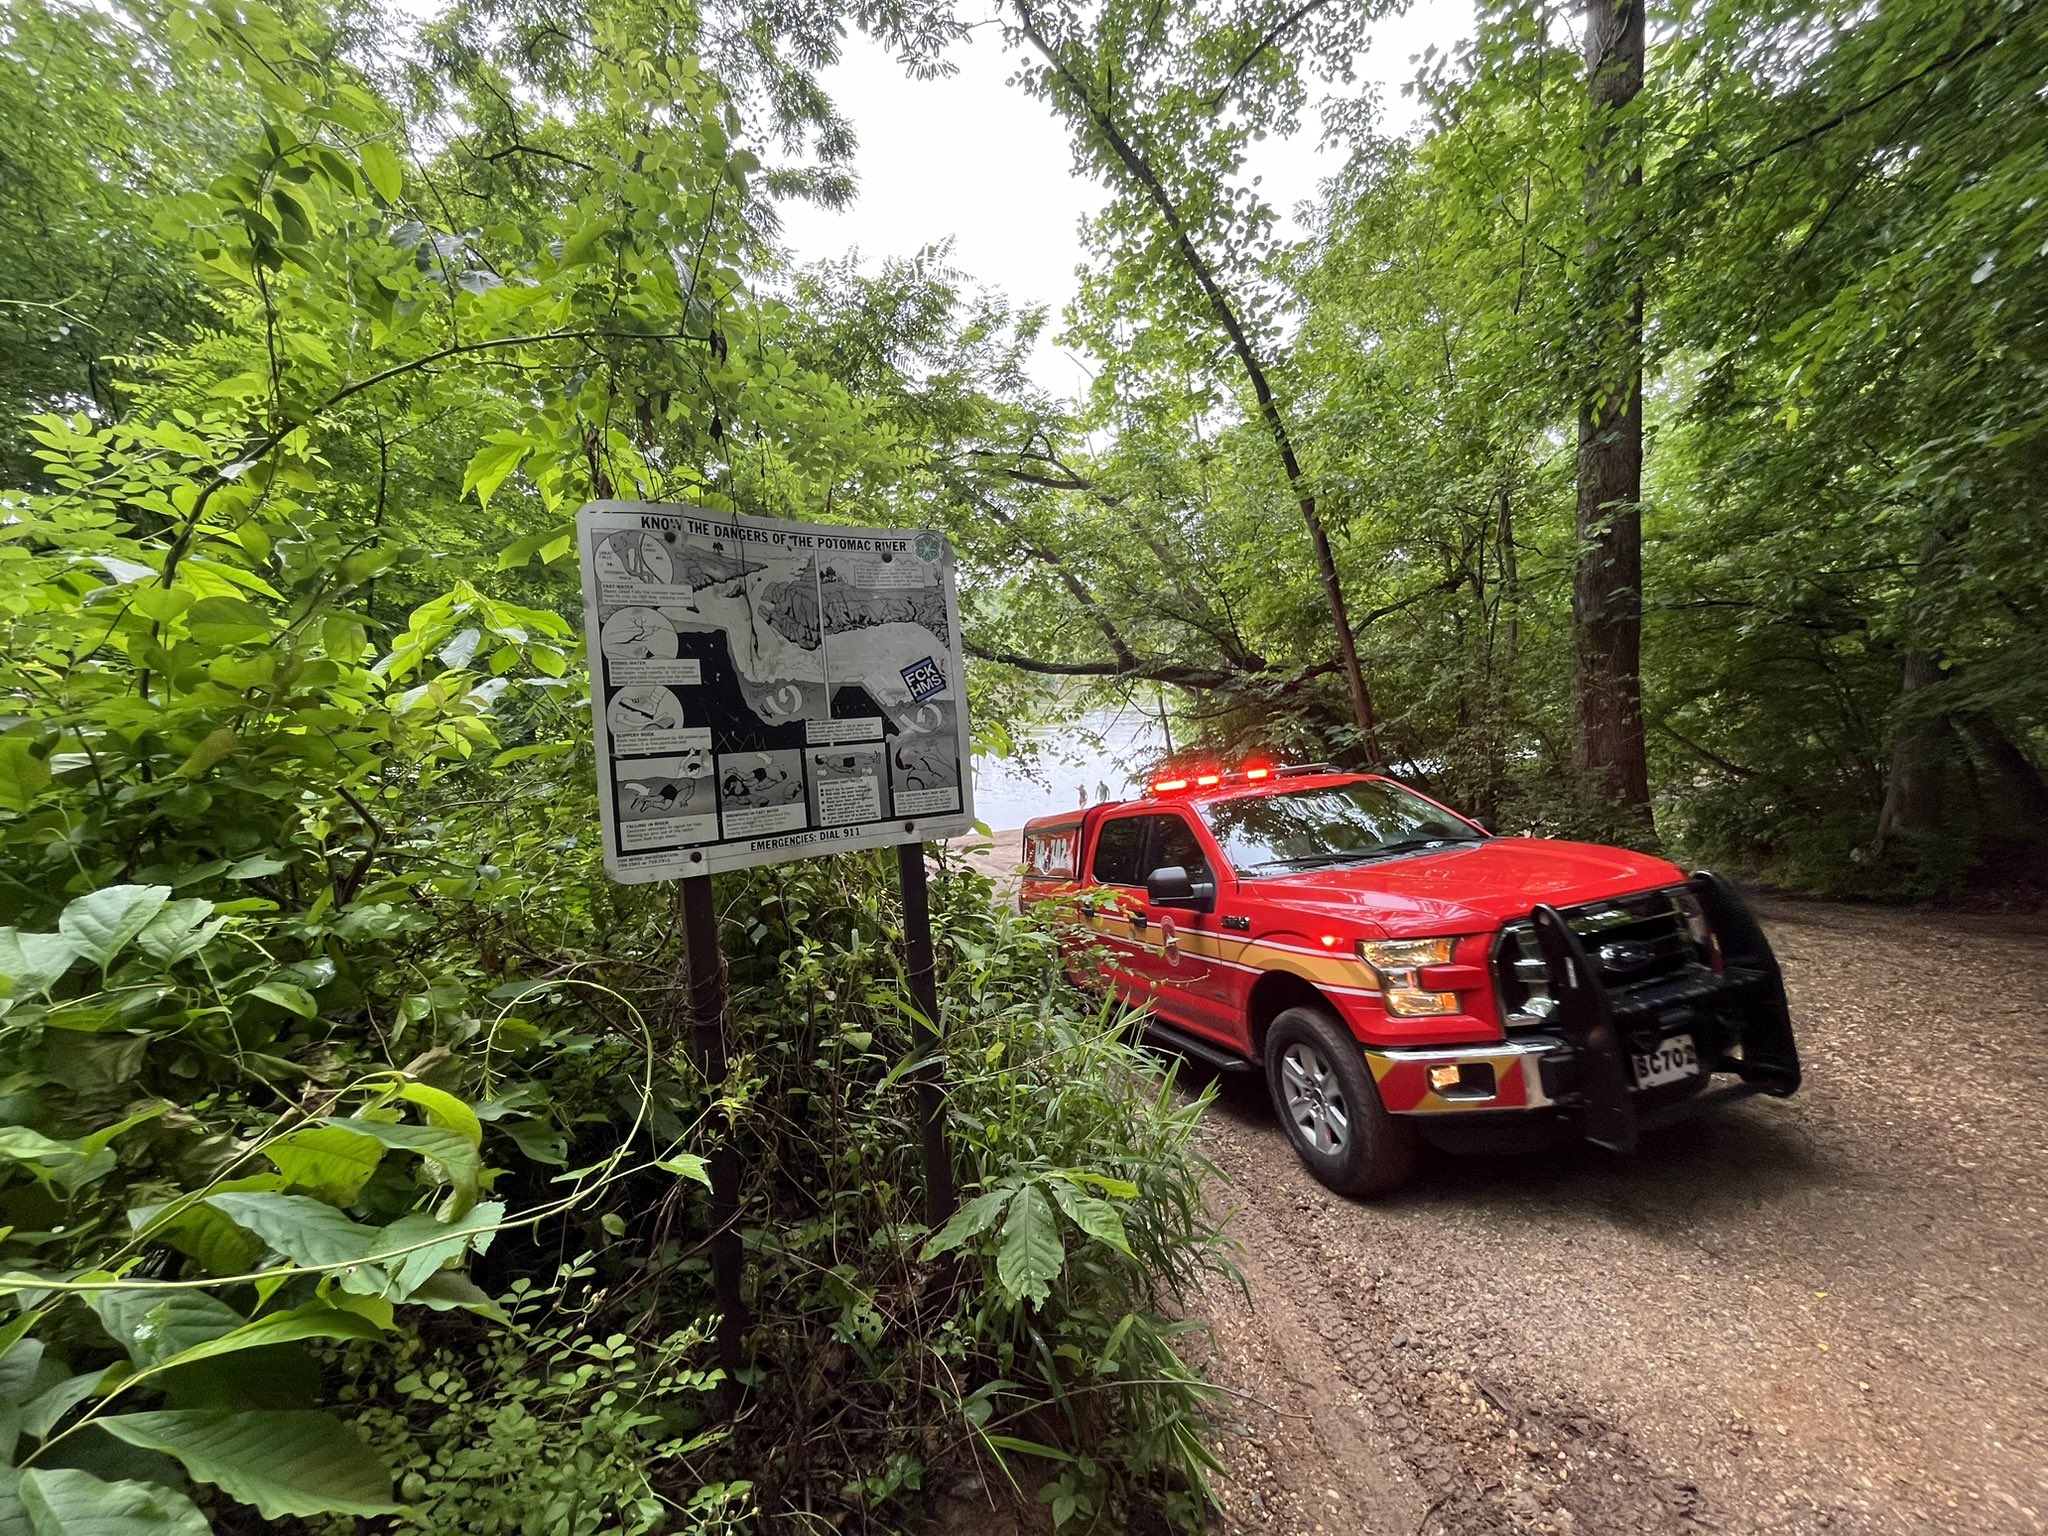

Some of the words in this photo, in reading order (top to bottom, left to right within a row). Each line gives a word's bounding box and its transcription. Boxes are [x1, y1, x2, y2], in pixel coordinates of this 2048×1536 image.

[687, 520, 710, 536] THE
[714, 525, 768, 543] DANGERS
[772, 532, 787, 545] OF
[792, 535, 813, 548] THE
[818, 537, 871, 551] POTOMAC
[874, 540, 907, 552] RIVER
[905, 663, 937, 686] FCK
[910, 674, 942, 697] HMS
[750, 833, 817, 852] EMERGENCIES:
[820, 829, 840, 841] DIAL
[843, 827, 860, 837] 911
